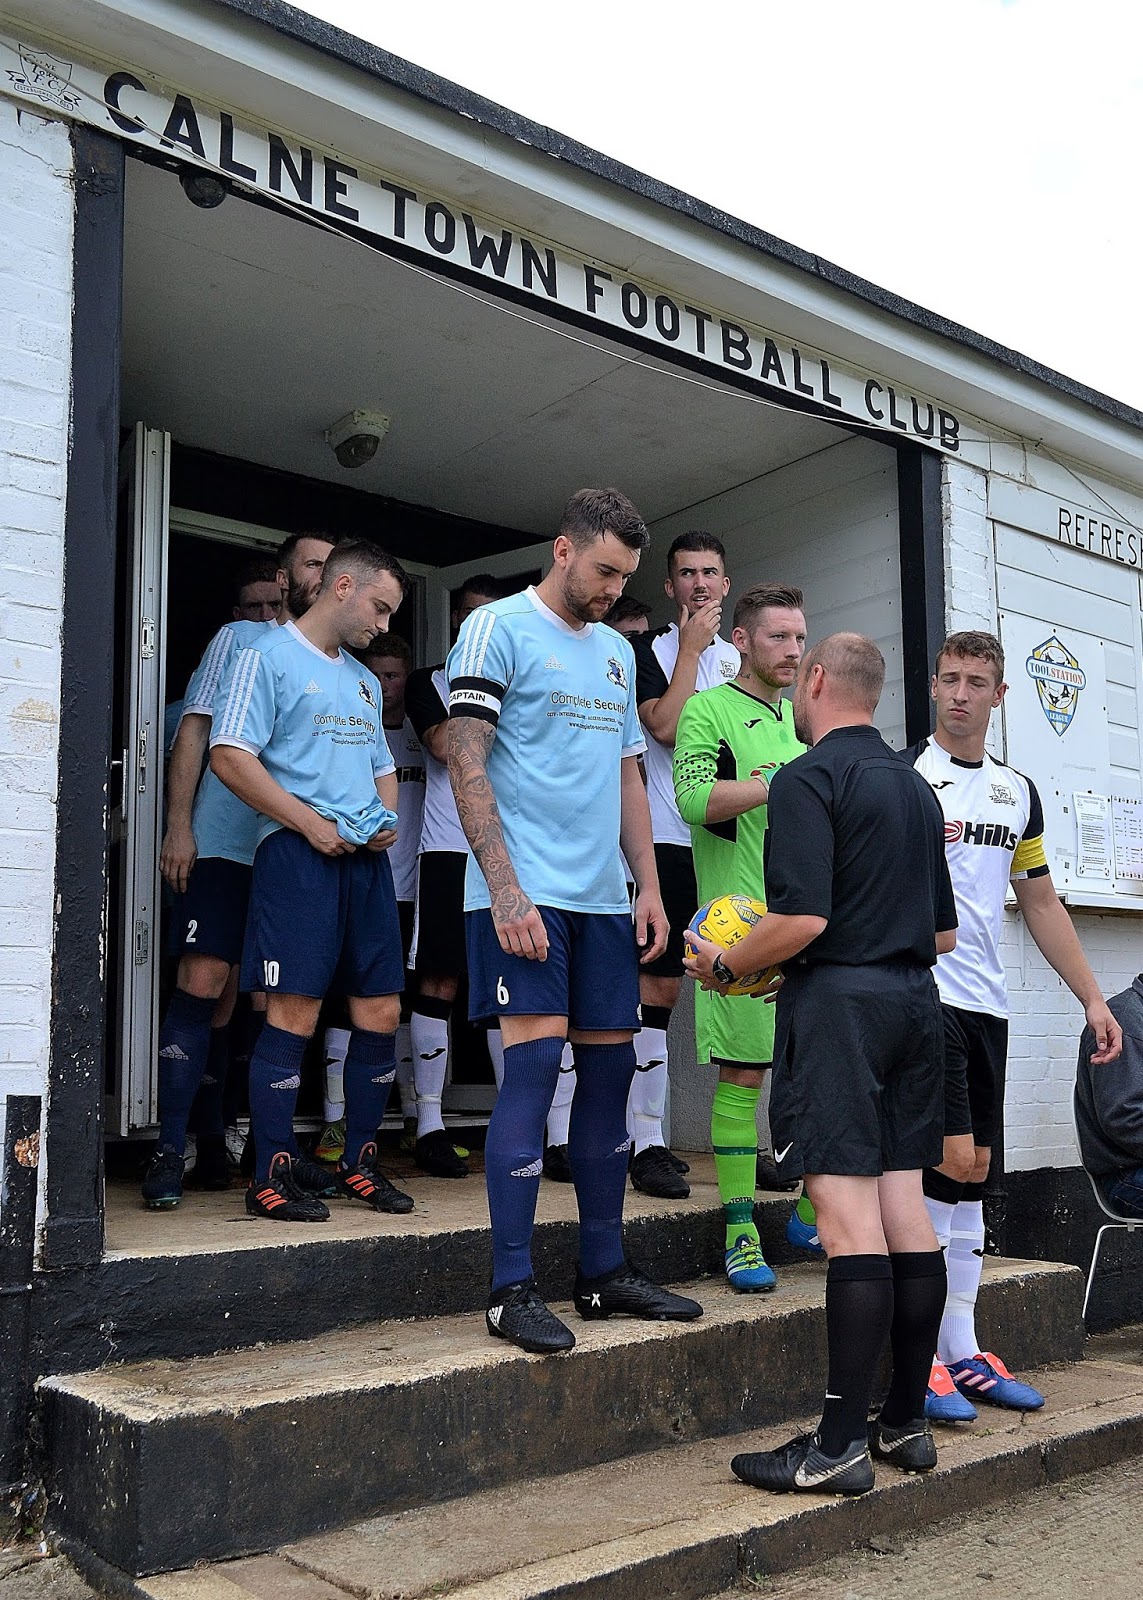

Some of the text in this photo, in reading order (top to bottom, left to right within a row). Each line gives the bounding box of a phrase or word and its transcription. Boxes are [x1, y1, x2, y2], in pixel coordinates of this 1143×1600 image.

[104, 72, 960, 453] CALNE TOWN FOOTBALL CLUB
[1029, 662, 1083, 685] TOOLSTATION
[450, 691, 486, 703] APTAIN
[551, 691, 592, 709] Complete
[963, 821, 1018, 852] Hills
[186, 919, 198, 943] 2
[263, 960, 280, 987] 10
[496, 976, 510, 1006] 6
